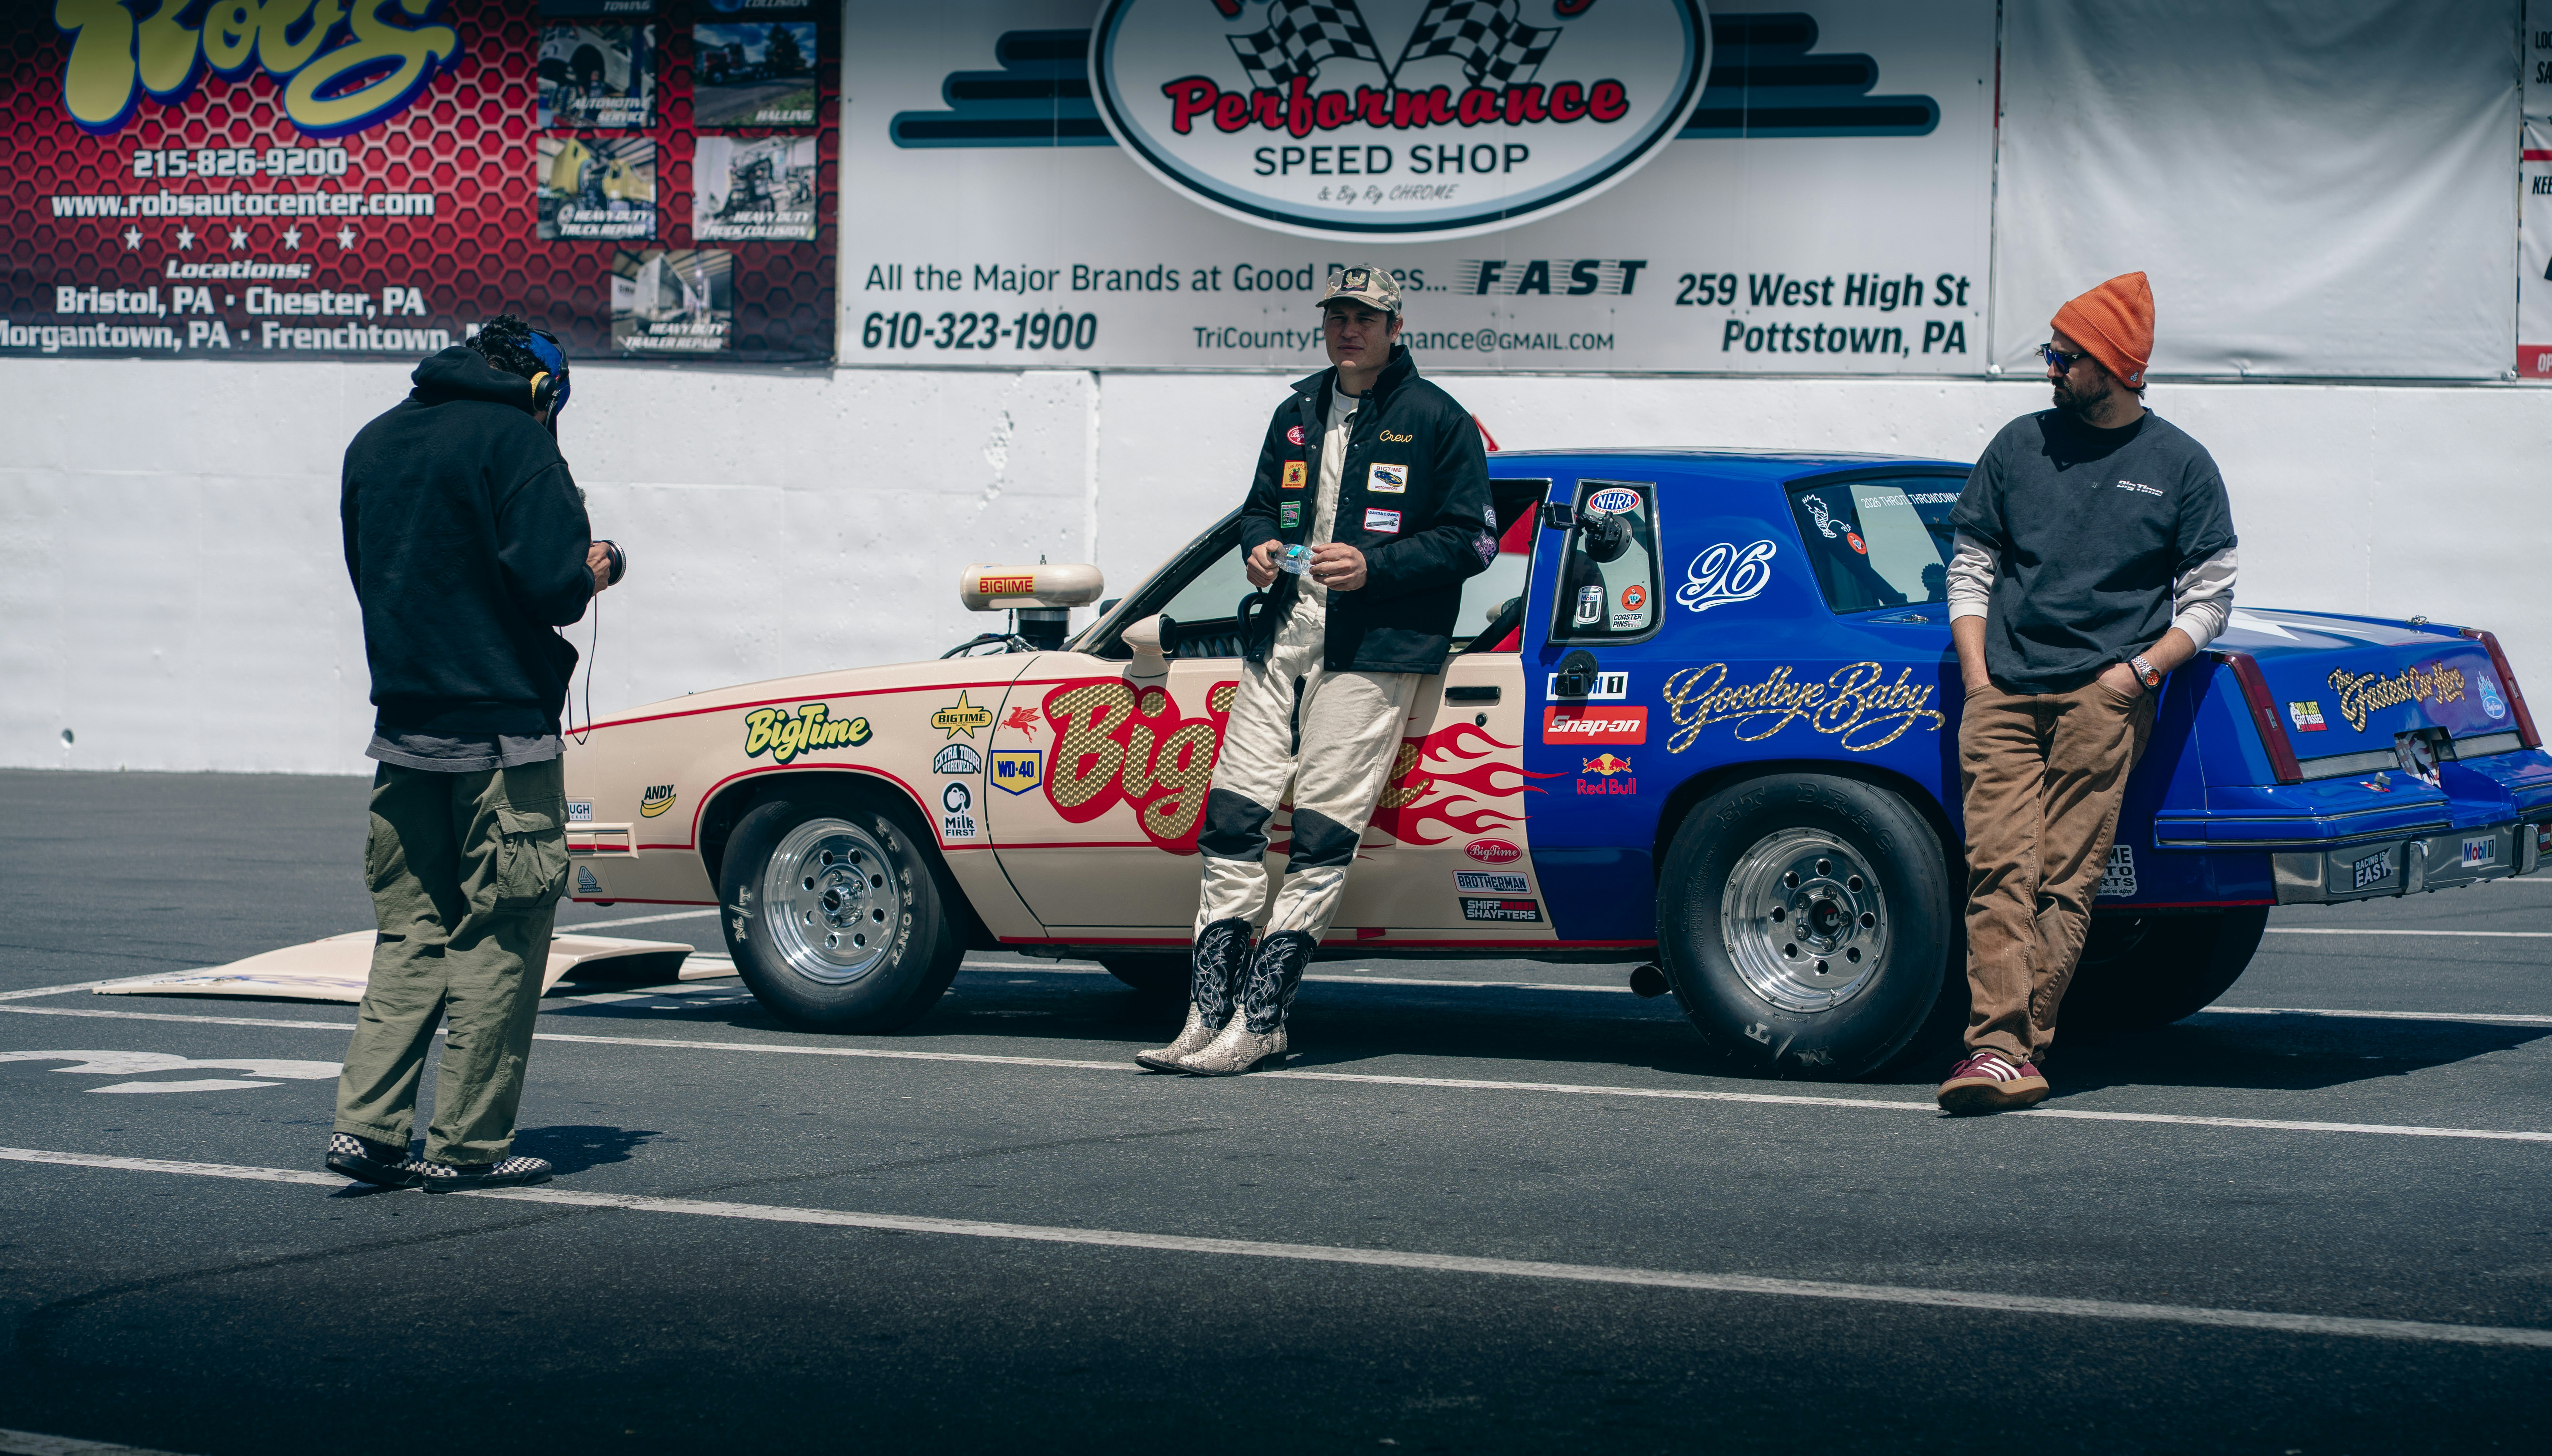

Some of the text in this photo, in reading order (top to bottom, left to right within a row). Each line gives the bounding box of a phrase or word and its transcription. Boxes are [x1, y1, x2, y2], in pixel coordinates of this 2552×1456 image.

[572, 98, 651, 109] AUTOMOTIVE
[1162, 75, 1630, 138] Performance
[596, 112, 647, 122] SERVICE
[133, 148, 347, 176] 215-826-9200
[1254, 144, 1529, 175] SPEED SHOP
[1317, 186, 1332, 201] &
[1388, 183, 1460, 201] CHROME
[52, 190, 434, 216] www.robsautocenter.com
[574, 210, 649, 223] HEAVY DUTY
[733, 211, 810, 223] HEAVY DUTY
[560, 224, 646, 235] TRUCK REPAIR
[702, 225, 808, 236] TRUCK COLLISION
[166, 260, 311, 279] Locations:
[864, 264, 901, 291] All
[914, 265, 962, 291] the
[974, 264, 1060, 294] Major
[1072, 264, 1179, 291] Brands
[1191, 267, 1221, 291] at
[1233, 263, 1313, 291] Good
[1476, 259, 1647, 295] FAST
[1676, 273, 1969, 312] 259 West High St
[57, 287, 425, 319] Bristol, PA Chester, PA
[189, 322, 230, 348] PA
[649, 323, 723, 335] HEAVY DUTY
[862, 311, 1097, 351] 610-323-1900
[625, 337, 723, 349] TRAILER REPAIR
[1722, 320, 1966, 358] Pottstown, PA
[1380, 430, 1412, 442] Crew
[1597, 494, 1632, 509] NHRA
[1861, 497, 1882, 508] 2026
[1879, 495, 1912, 507] THROTL
[1908, 493, 1956, 505] THROWDOWN
[1475, 541, 1489, 566] BIGTIME
[1676, 540, 1776, 612] 96
[980, 577, 1033, 593] BIGTIME
[1585, 602, 1590, 617] 1
[1612, 677, 1619, 692] 1
[2328, 660, 2465, 732] The Fastest Car Here
[1663, 662, 1945, 753] Goodbye Baby
[2295, 702, 2320, 715] YOU JUST
[938, 713, 986, 723] BIGTIME
[1548, 715, 1640, 736] Snap-on
[2296, 714, 2324, 725] GOT PASSED
[745, 703, 873, 764] BigTime
[935, 745, 980, 772] EXTRA TOUGH
[942, 760, 973, 772] WORKWEAR
[997, 761, 1034, 778] WD-40
[644, 784, 674, 801] ANDY
[1577, 778, 1636, 795] Red Bull
[570, 804, 589, 814] UGH
[945, 815, 974, 829] Milk
[1716, 782, 1897, 856] ET DRAG
[1470, 844, 1517, 860] BigTime
[2108, 848, 2131, 864] ME
[2464, 840, 2494, 862] Mobil 1
[2356, 854, 2378, 871] RACING
[2106, 866, 2132, 876] TO
[2356, 863, 2388, 888] EASY
[1458, 875, 1527, 889] BROTHERMAN
[2101, 878, 2134, 886] RTS
[1467, 900, 1501, 909] SHIFF
[892, 870, 913, 966] FRONT
[1467, 909, 1536, 919] SHAYFTERS
